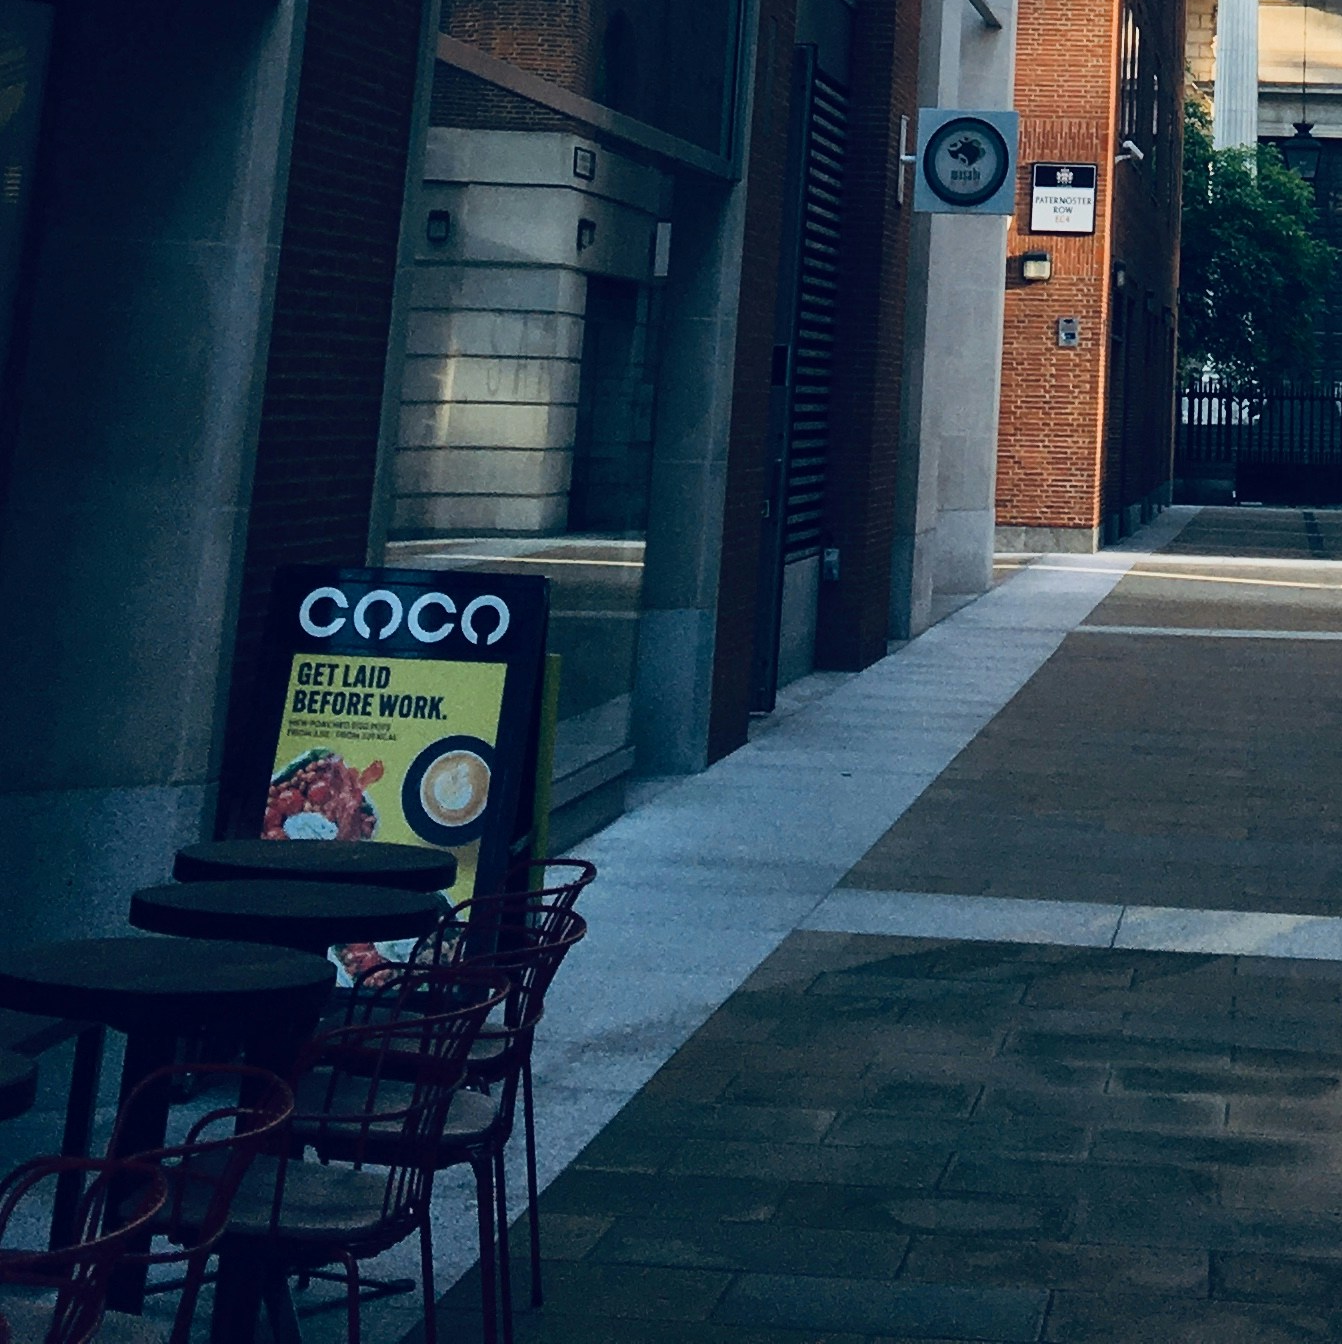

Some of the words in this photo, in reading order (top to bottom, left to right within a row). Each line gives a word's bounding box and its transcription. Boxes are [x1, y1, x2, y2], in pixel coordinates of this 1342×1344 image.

[1035, 196, 1092, 205] PATERNOSTER
[1053, 206, 1073, 214] ROW
[299, 586, 510, 646] COCO
[297, 662, 338, 686] GET
[341, 665, 391, 689] LAID
[292, 690, 373, 717] BEFORE
[379, 696, 448, 721] WORK.
